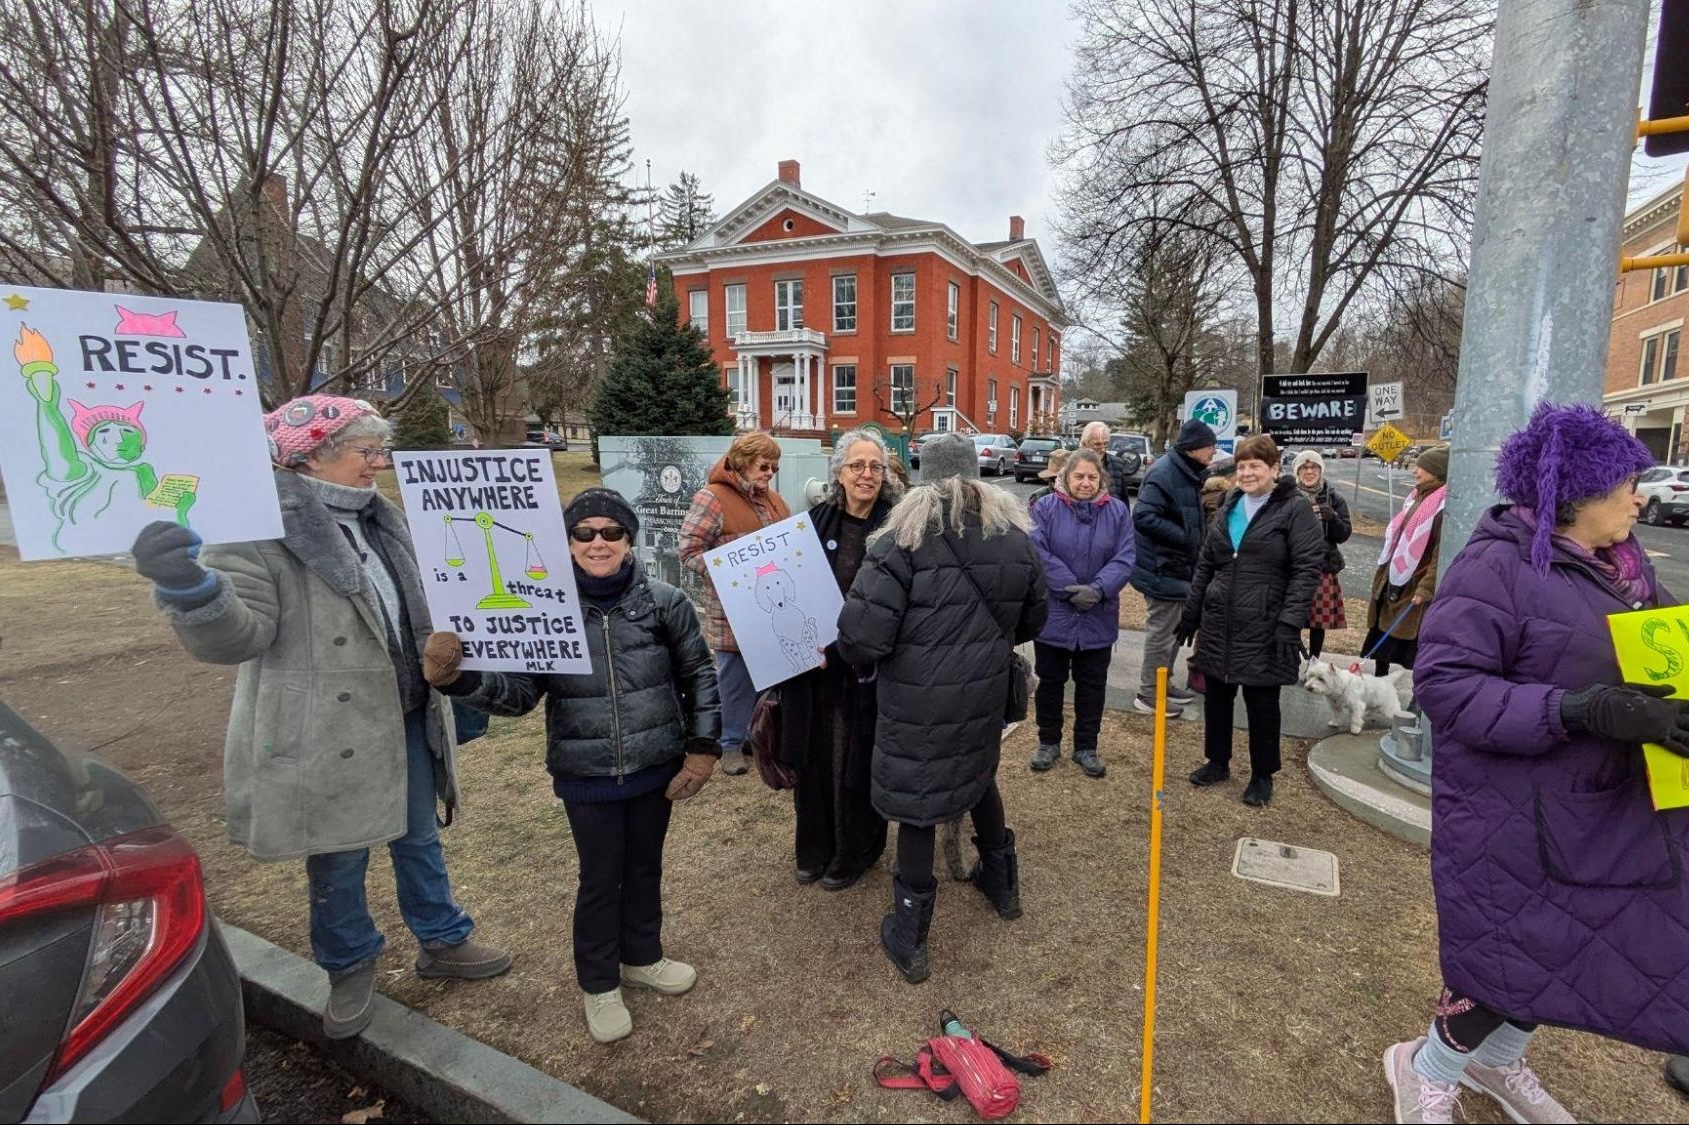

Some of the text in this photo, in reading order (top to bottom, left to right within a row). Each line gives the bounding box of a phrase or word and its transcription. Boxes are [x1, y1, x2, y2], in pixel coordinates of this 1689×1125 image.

[79, 335, 246, 380] RESIST.
[1375, 385, 1397, 396] ONE
[1270, 400, 1354, 420] BEWARE
[1375, 396, 1397, 406] WAY
[1371, 440, 1407, 451] OUTLET
[1382, 431, 1395, 440] NO
[401, 456, 543, 484] INJUSTICE
[422, 486, 539, 511] ANYWHERE
[636, 505, 658, 514] Great
[727, 532, 789, 567] RESIST
[433, 568, 467, 583] is a
[506, 581, 566, 603] threat
[450, 612, 577, 635] TO JUSTICE
[462, 639, 582, 660] EVERYWHERE
[1641, 618, 1689, 682] S
[526, 661, 556, 671] MLK
